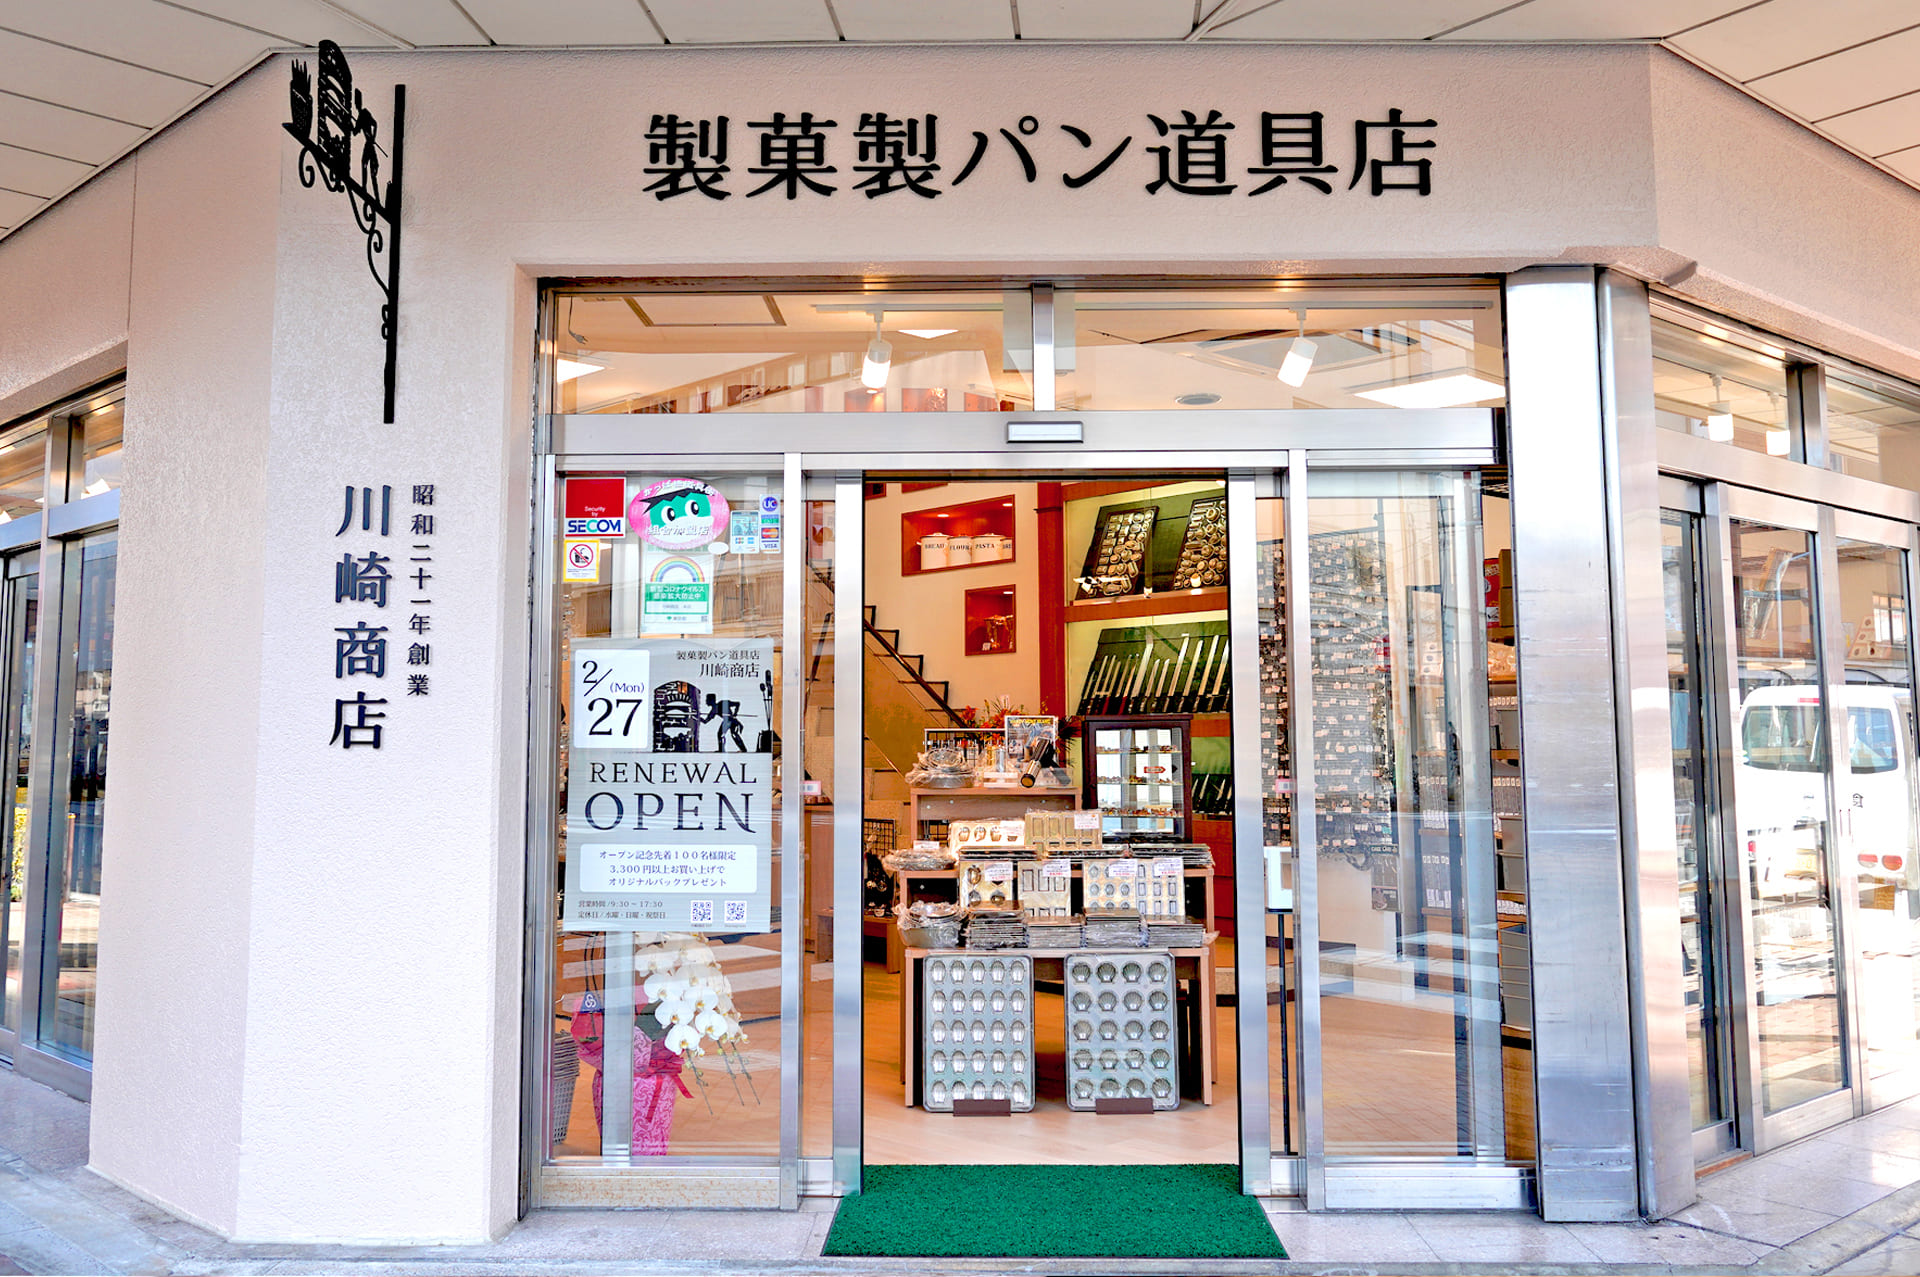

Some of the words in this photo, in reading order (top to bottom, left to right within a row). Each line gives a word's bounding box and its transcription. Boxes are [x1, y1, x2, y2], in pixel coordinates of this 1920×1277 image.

[642, 107, 1438, 202] 製菓製パン道具店
[567, 519, 621, 533] SECOM
[406, 484, 434, 696] 昭和二十一年創業
[329, 484, 392, 750] 川崎商店
[677, 650, 760, 661] 製菓製パン道具店
[699, 662, 760, 678] 川崎商店
[609, 682, 645, 694] (Mon)
[587, 697, 643, 737] 27
[589, 761, 757, 785] RENEWAL
[584, 791, 757, 834] OPEN
